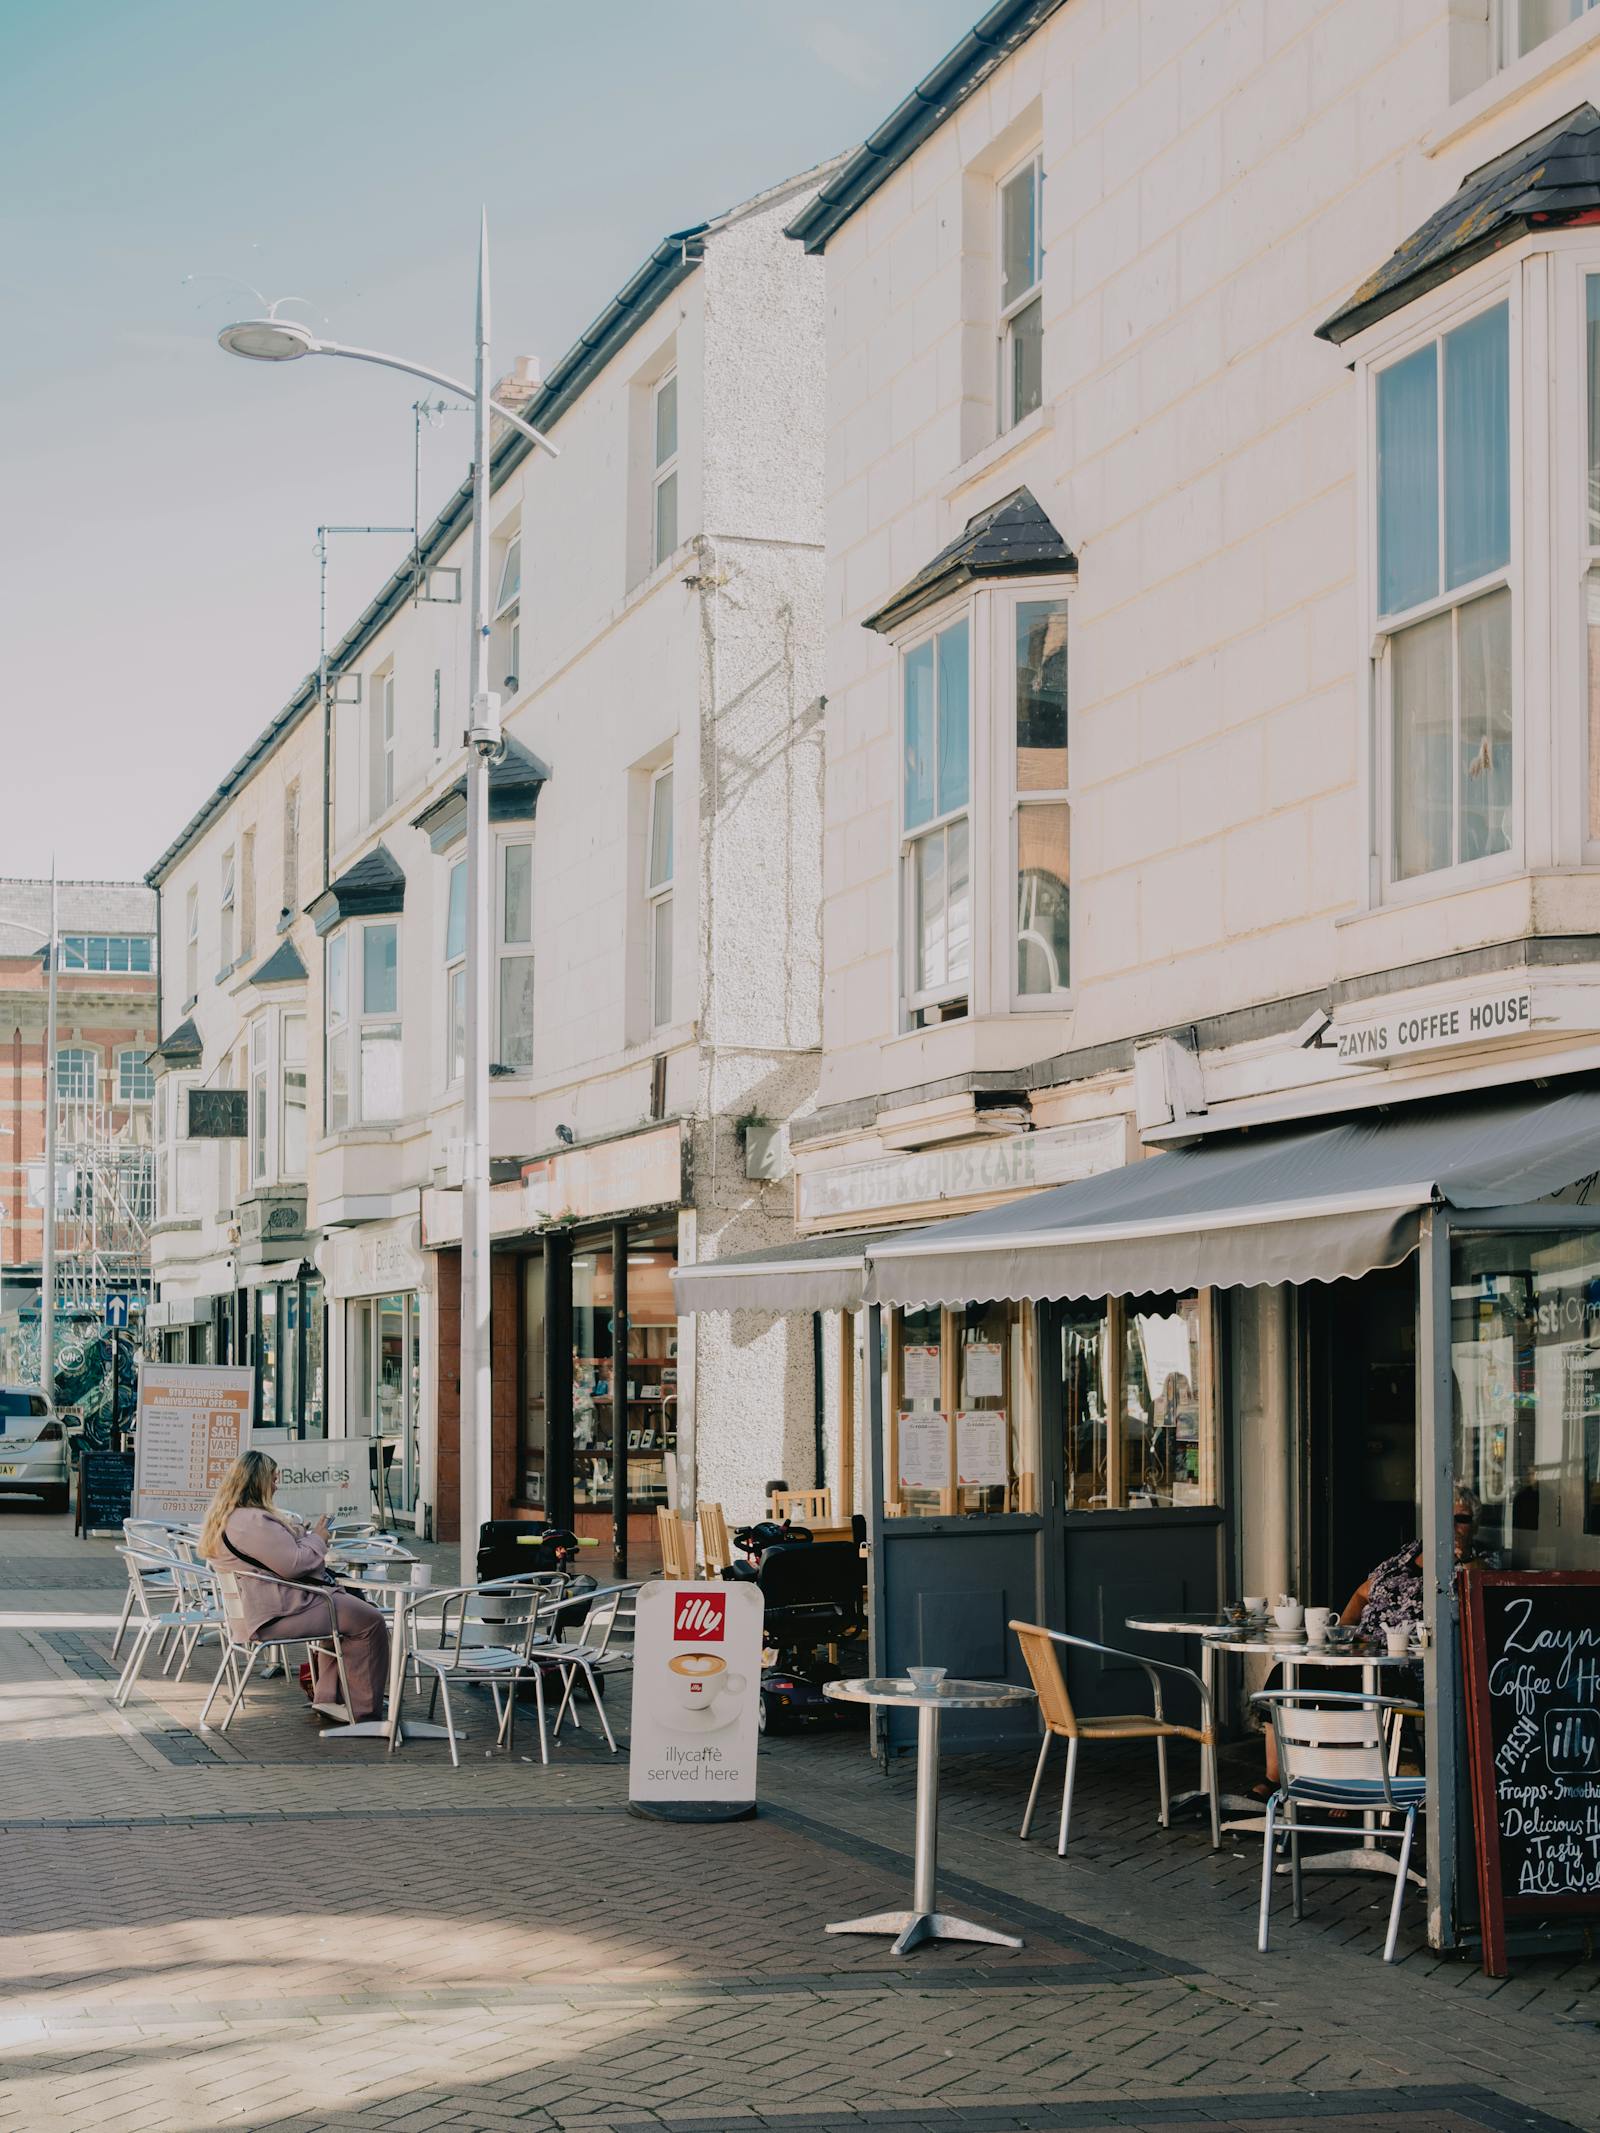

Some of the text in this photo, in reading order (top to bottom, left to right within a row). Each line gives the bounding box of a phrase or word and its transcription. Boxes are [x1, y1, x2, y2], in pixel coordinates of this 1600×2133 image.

[1338, 995, 1529, 1057] ZAYNS COFFEE HOUSE
[914, 1148, 975, 1196] CHIPS
[980, 1137, 1036, 1187] CAFE
[153, 1397, 238, 1409] ANNIVERSARY OFFERS
[168, 1388, 224, 1399] 9TH BUSINESS
[211, 1426, 237, 1439] SALE
[215, 1415, 234, 1426] BIG
[211, 1440, 237, 1450] VAPE
[162, 1502, 186, 1512] 07913
[676, 1598, 723, 1638] illy
[1488, 1657, 1552, 1716] Coffee
[665, 1746, 723, 1767] illycaffè
[1495, 1715, 1540, 1776] FRESH
[1552, 1716, 1596, 1768] illy
[647, 1766, 740, 1782] served here
[1498, 1778, 1548, 1809] Frapps
[1502, 1805, 1584, 1837] Delicious
[1530, 1834, 1584, 1869] Tasty
[1518, 1859, 1560, 1891] All
